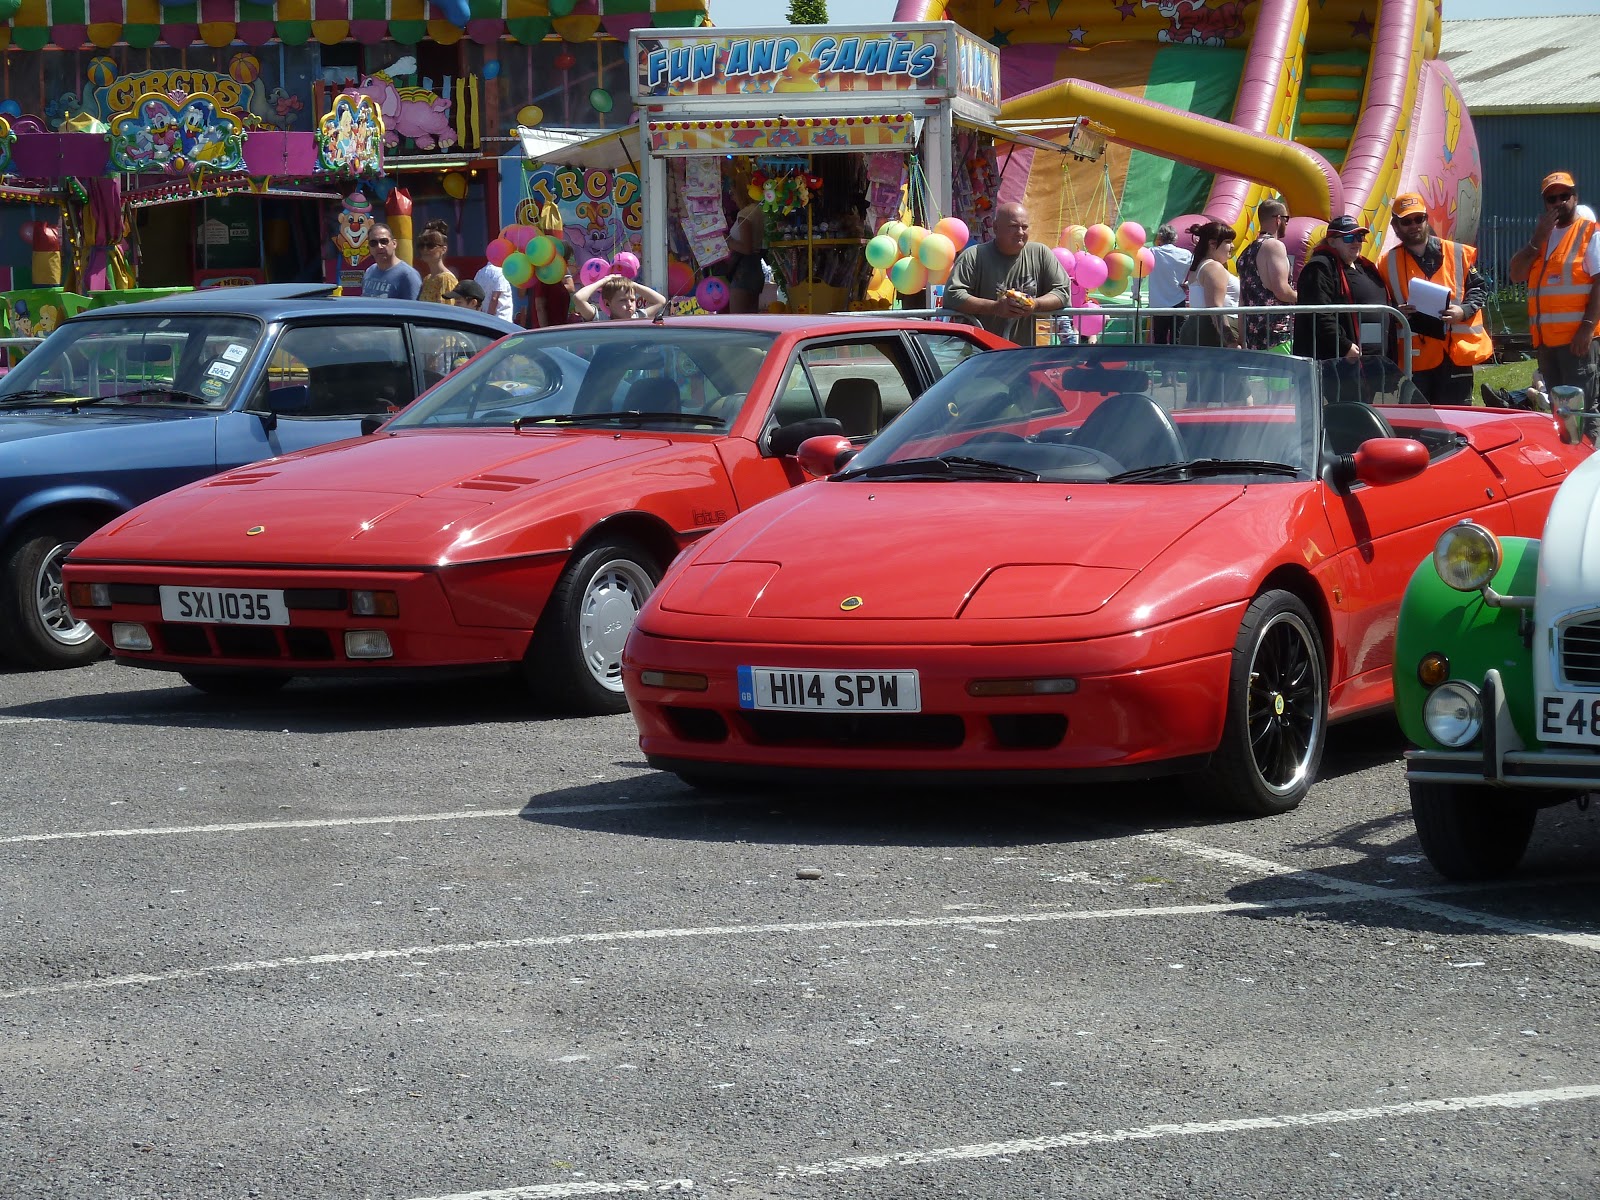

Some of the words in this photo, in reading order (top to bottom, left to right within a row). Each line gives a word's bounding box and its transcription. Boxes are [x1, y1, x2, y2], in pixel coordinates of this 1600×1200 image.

[648, 44, 717, 87] FUN
[724, 36, 801, 77] AND
[808, 36, 937, 78] GAMES
[108, 71, 241, 112] CIRCUS
[520, 171, 642, 229] CIRCUS
[211, 367, 230, 378] RAC
[218, 592, 271, 621] 1035
[741, 691, 752, 702] GB
[769, 672, 826, 706] H114
[834, 674, 899, 707] SPW
